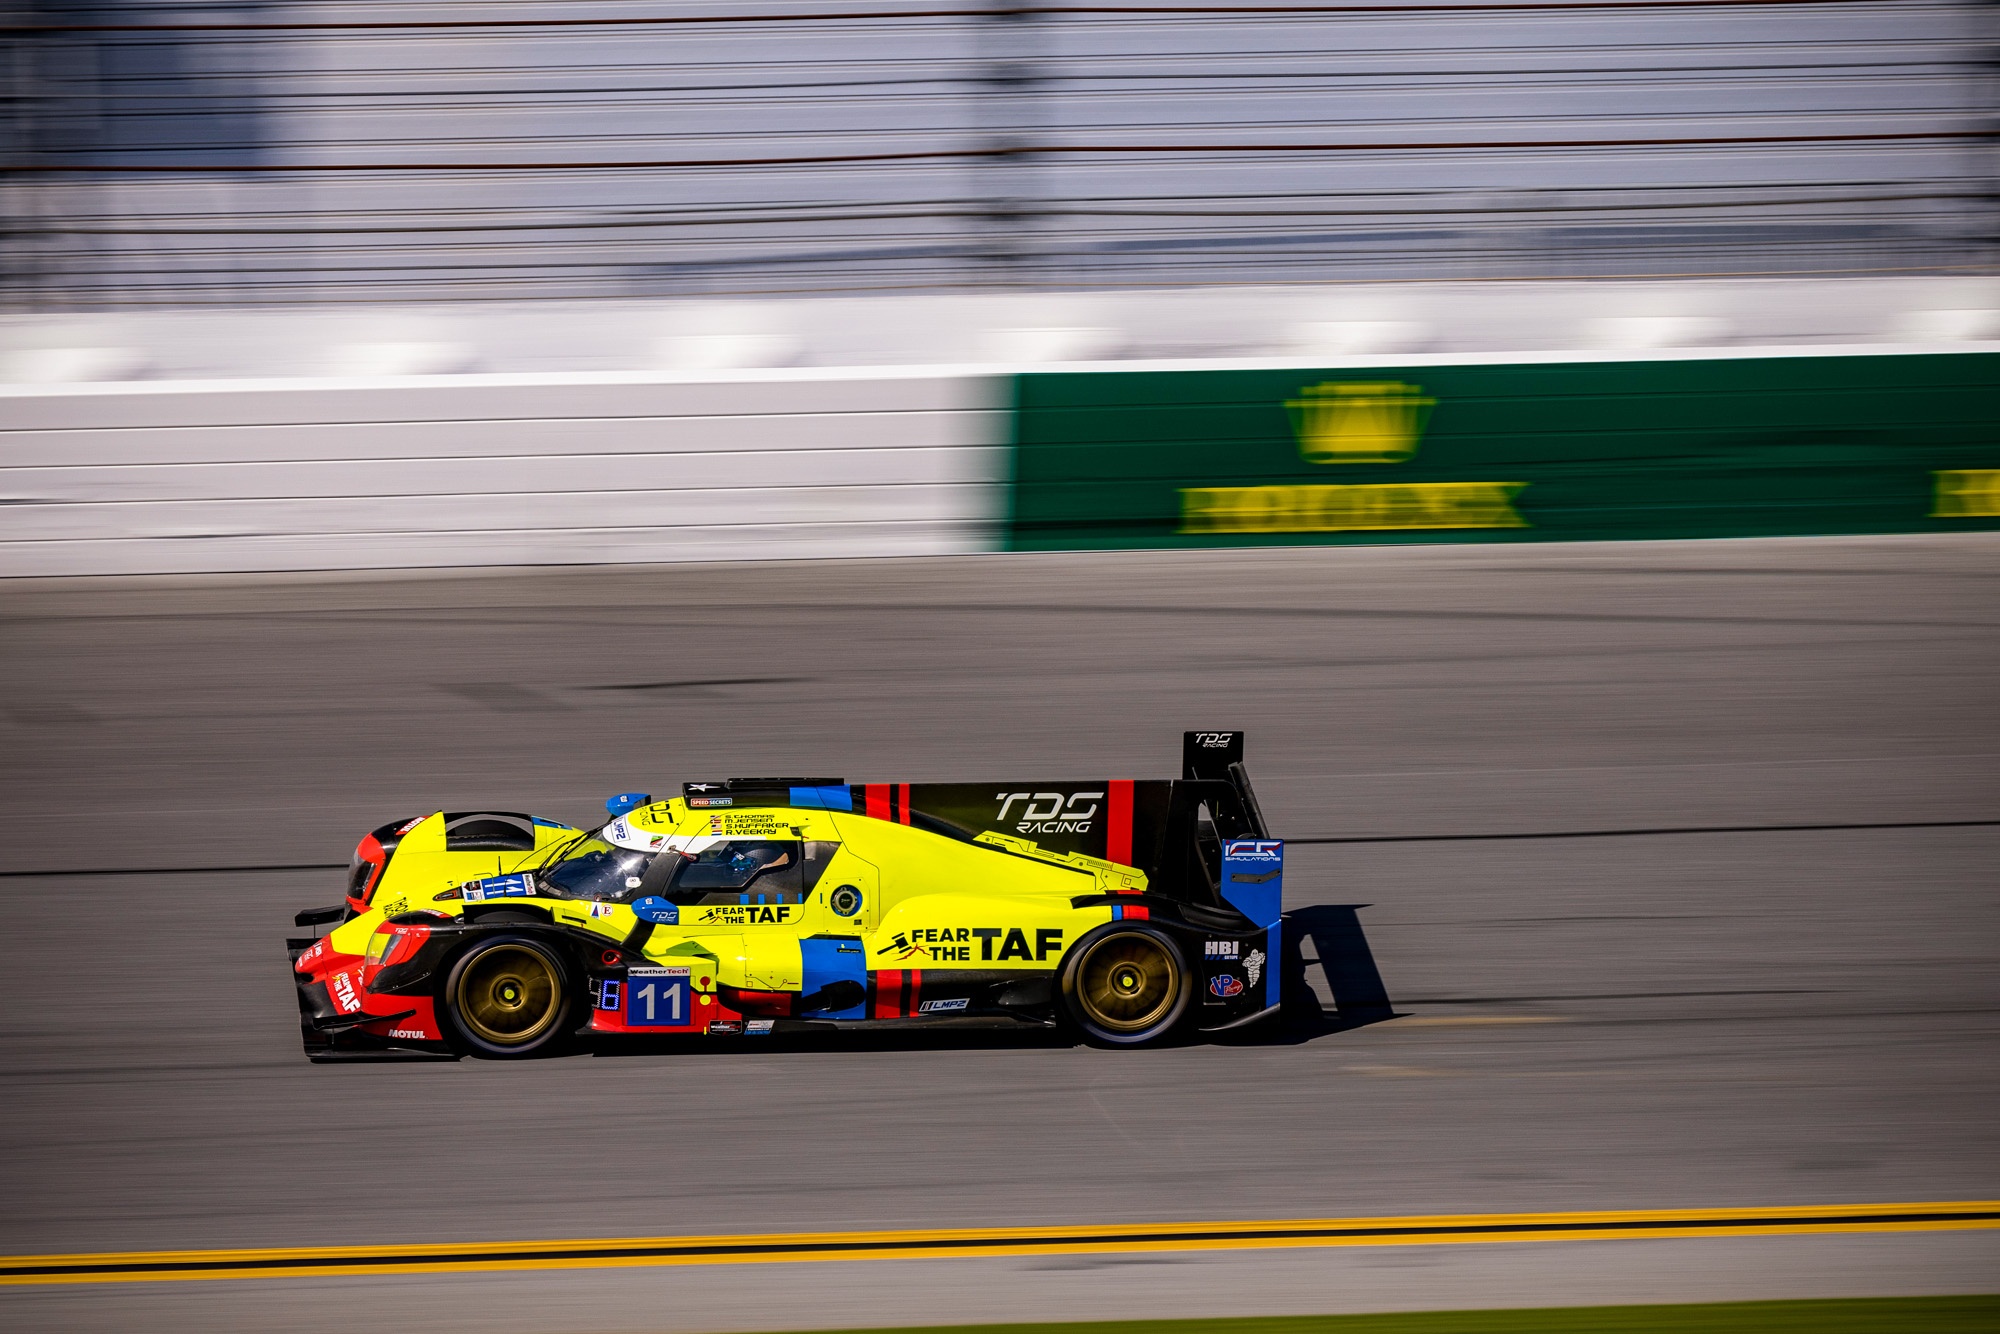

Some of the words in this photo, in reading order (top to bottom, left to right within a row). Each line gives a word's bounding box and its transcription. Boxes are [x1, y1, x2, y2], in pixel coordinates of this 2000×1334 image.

[1196, 733, 1232, 743] TDS
[996, 792, 1104, 820] TDS
[1016, 821, 1092, 833] RACING
[603, 906, 611, 915] E
[652, 911, 677, 919] TDS
[715, 907, 744, 915] FEAR
[745, 906, 790, 923] TAF
[724, 916, 744, 924] THE
[912, 928, 970, 943] FEAR
[972, 928, 1063, 961] TAF
[1205, 941, 1239, 955] HBI
[929, 947, 970, 960] THE
[1211, 974, 1234, 996] VP
[338, 987, 361, 1012] TAF
[637, 983, 681, 1019] 11
[932, 1001, 967, 1009] LMP2
[388, 1029, 425, 1039] MOTUL
